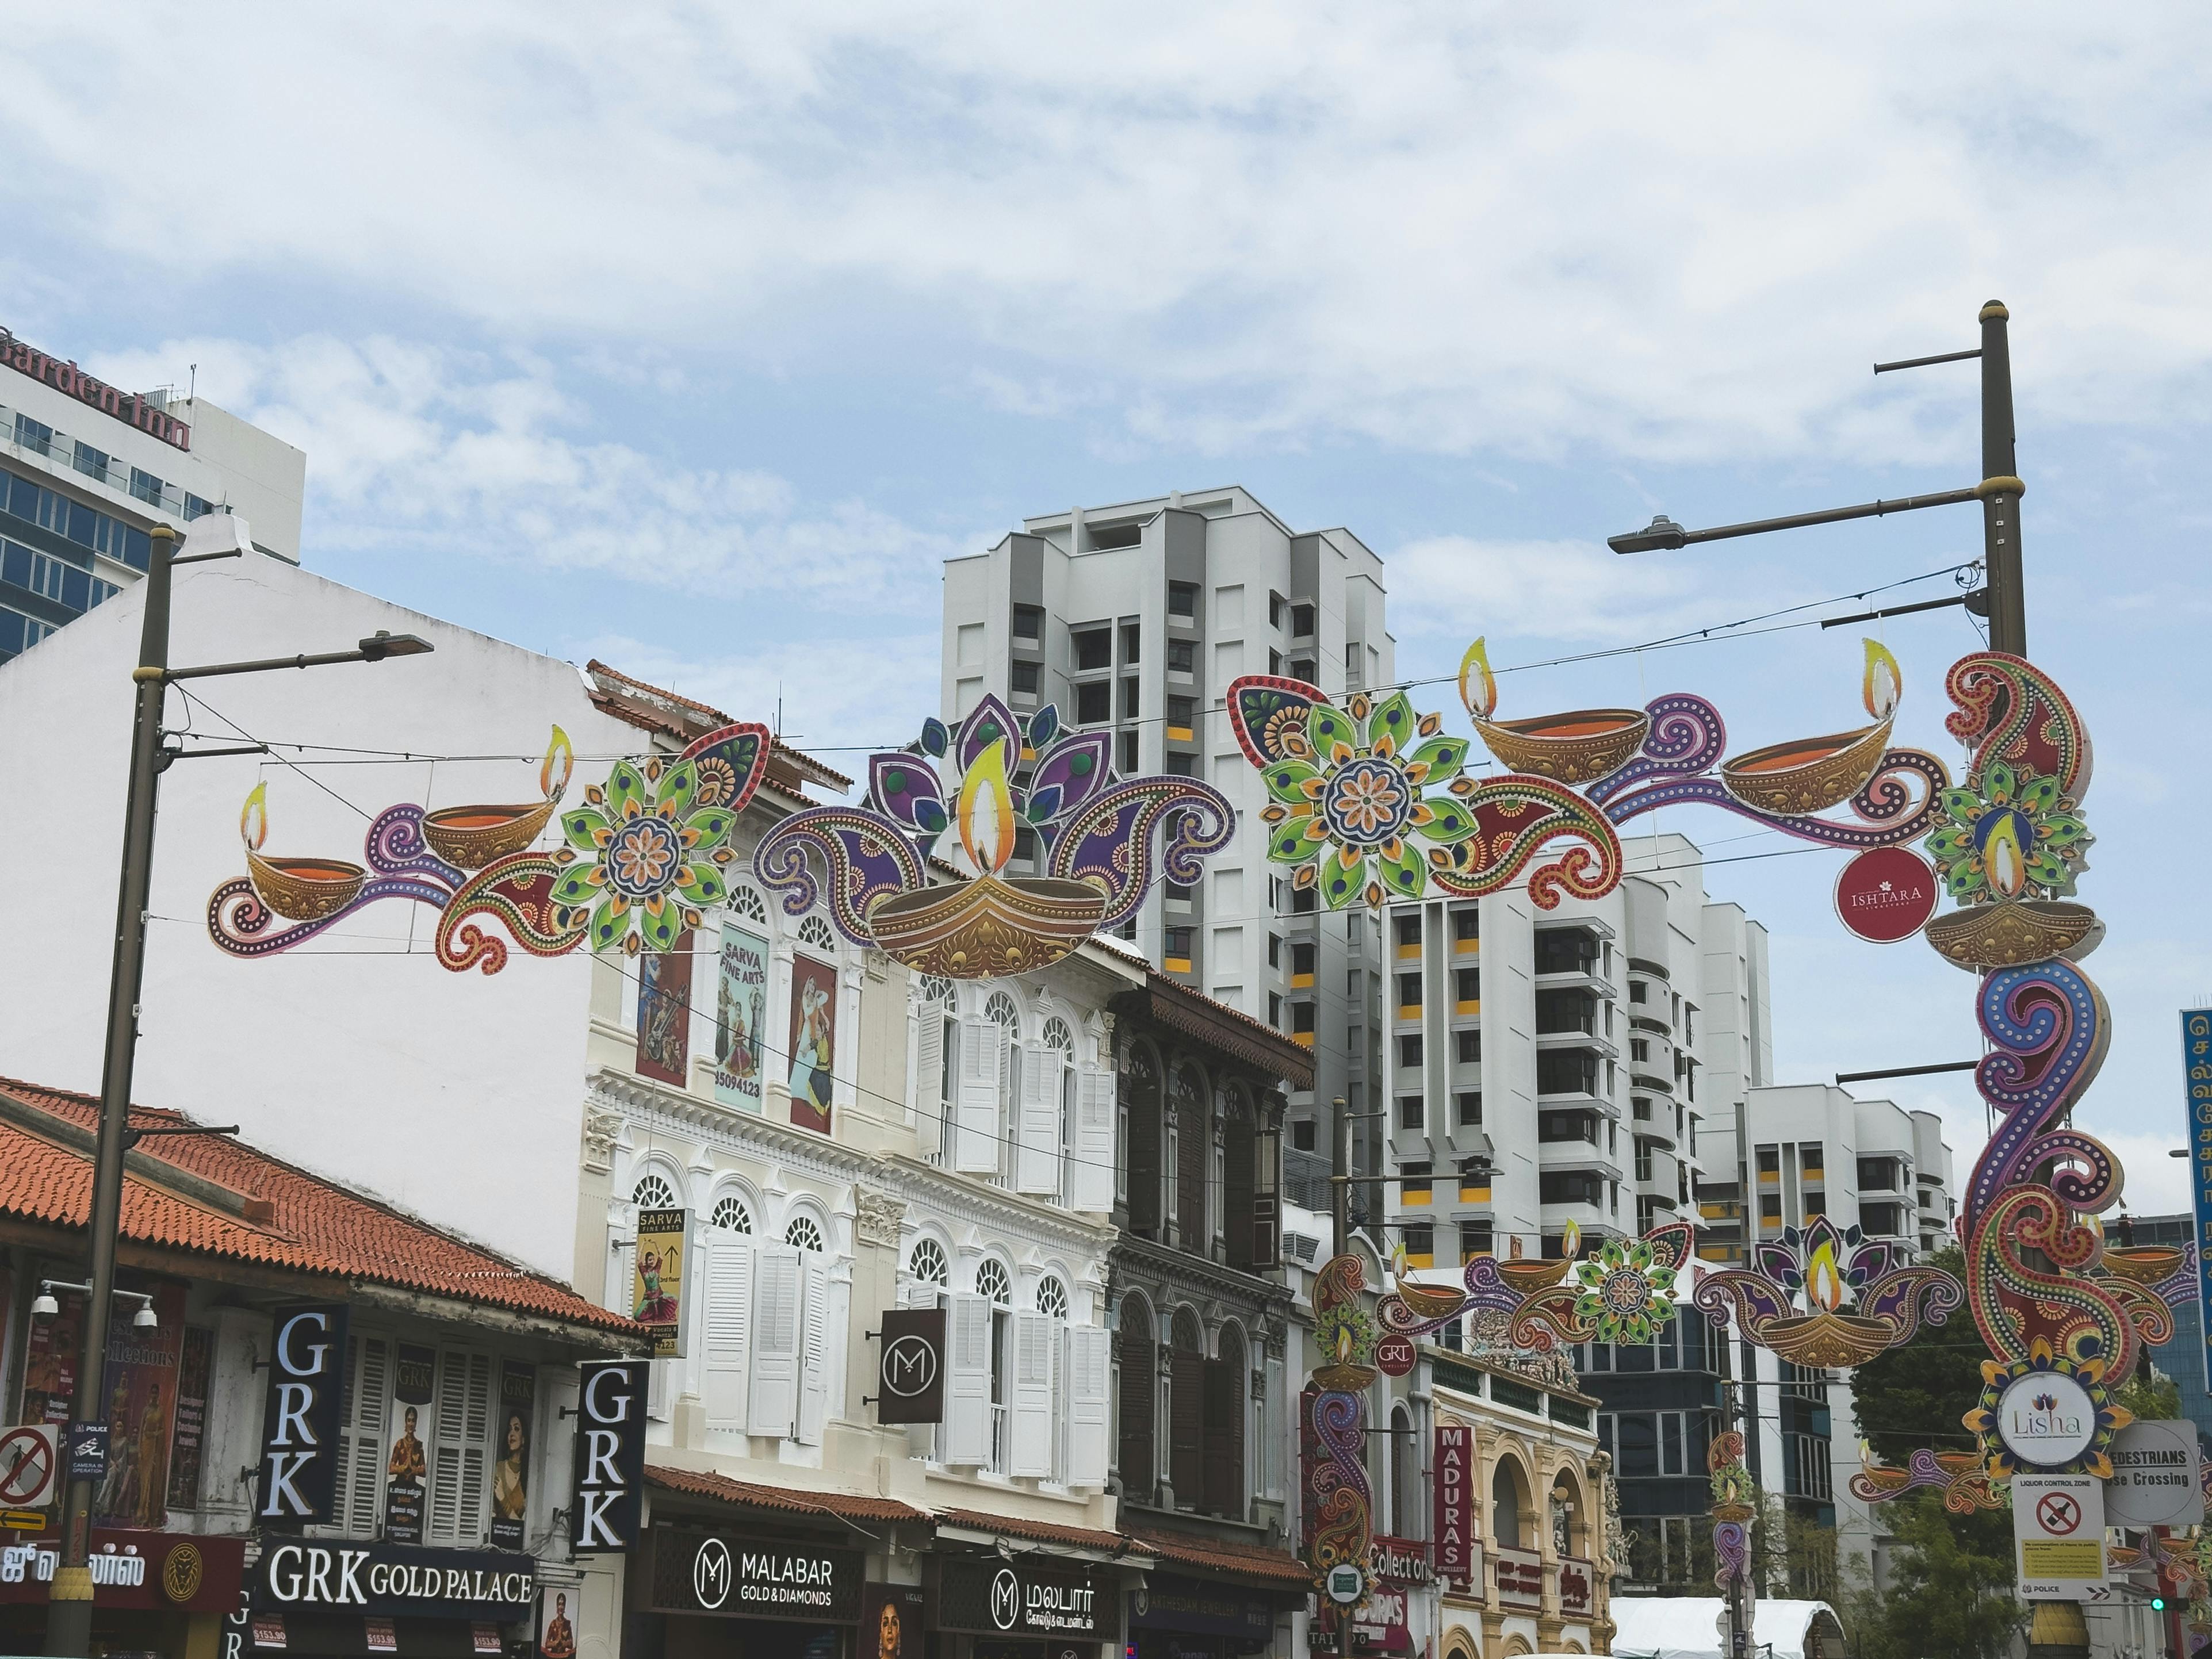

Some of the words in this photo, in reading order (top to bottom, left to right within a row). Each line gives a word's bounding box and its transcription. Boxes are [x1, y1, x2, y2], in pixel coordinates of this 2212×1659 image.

[131, 392, 190, 451] Inn
[1851, 887, 1922, 907] ISHTARA
[726, 942, 761, 971] SARVA
[720, 955, 740, 981] FINE
[742, 970, 765, 985] ARTS
[640, 1213, 682, 1225] SARVA
[106, 1341, 175, 1367] ollections
[1379, 1345, 1410, 1361] GRT
[398, 1365, 430, 1389] GRK
[504, 1377, 531, 1399] GRK
[261, 1312, 328, 1515] GRK
[2014, 1409, 2081, 1434] Lisha
[576, 1368, 630, 1547] GRK
[2110, 1450, 2187, 1465] EDESTRIANS
[2133, 1472, 2189, 1487] Crossing
[1441, 1430, 1463, 1564] MADURAS
[742, 1553, 832, 1586] MALABAR
[1369, 1543, 1427, 1581] Collecton
[270, 1545, 370, 1604] GRK
[370, 1564, 441, 1597] GOLD
[444, 1569, 532, 1603] PALACE
[741, 1585, 770, 1601] GOLD
[771, 1587, 778, 1601] &
[779, 1588, 832, 1606] DIAMONDS
[253, 1630, 286, 1641] $153.90
[368, 1634, 395, 1643] $153.90
[474, 1637, 500, 1646] $153.90
[1309, 1632, 1366, 1645] TATO
